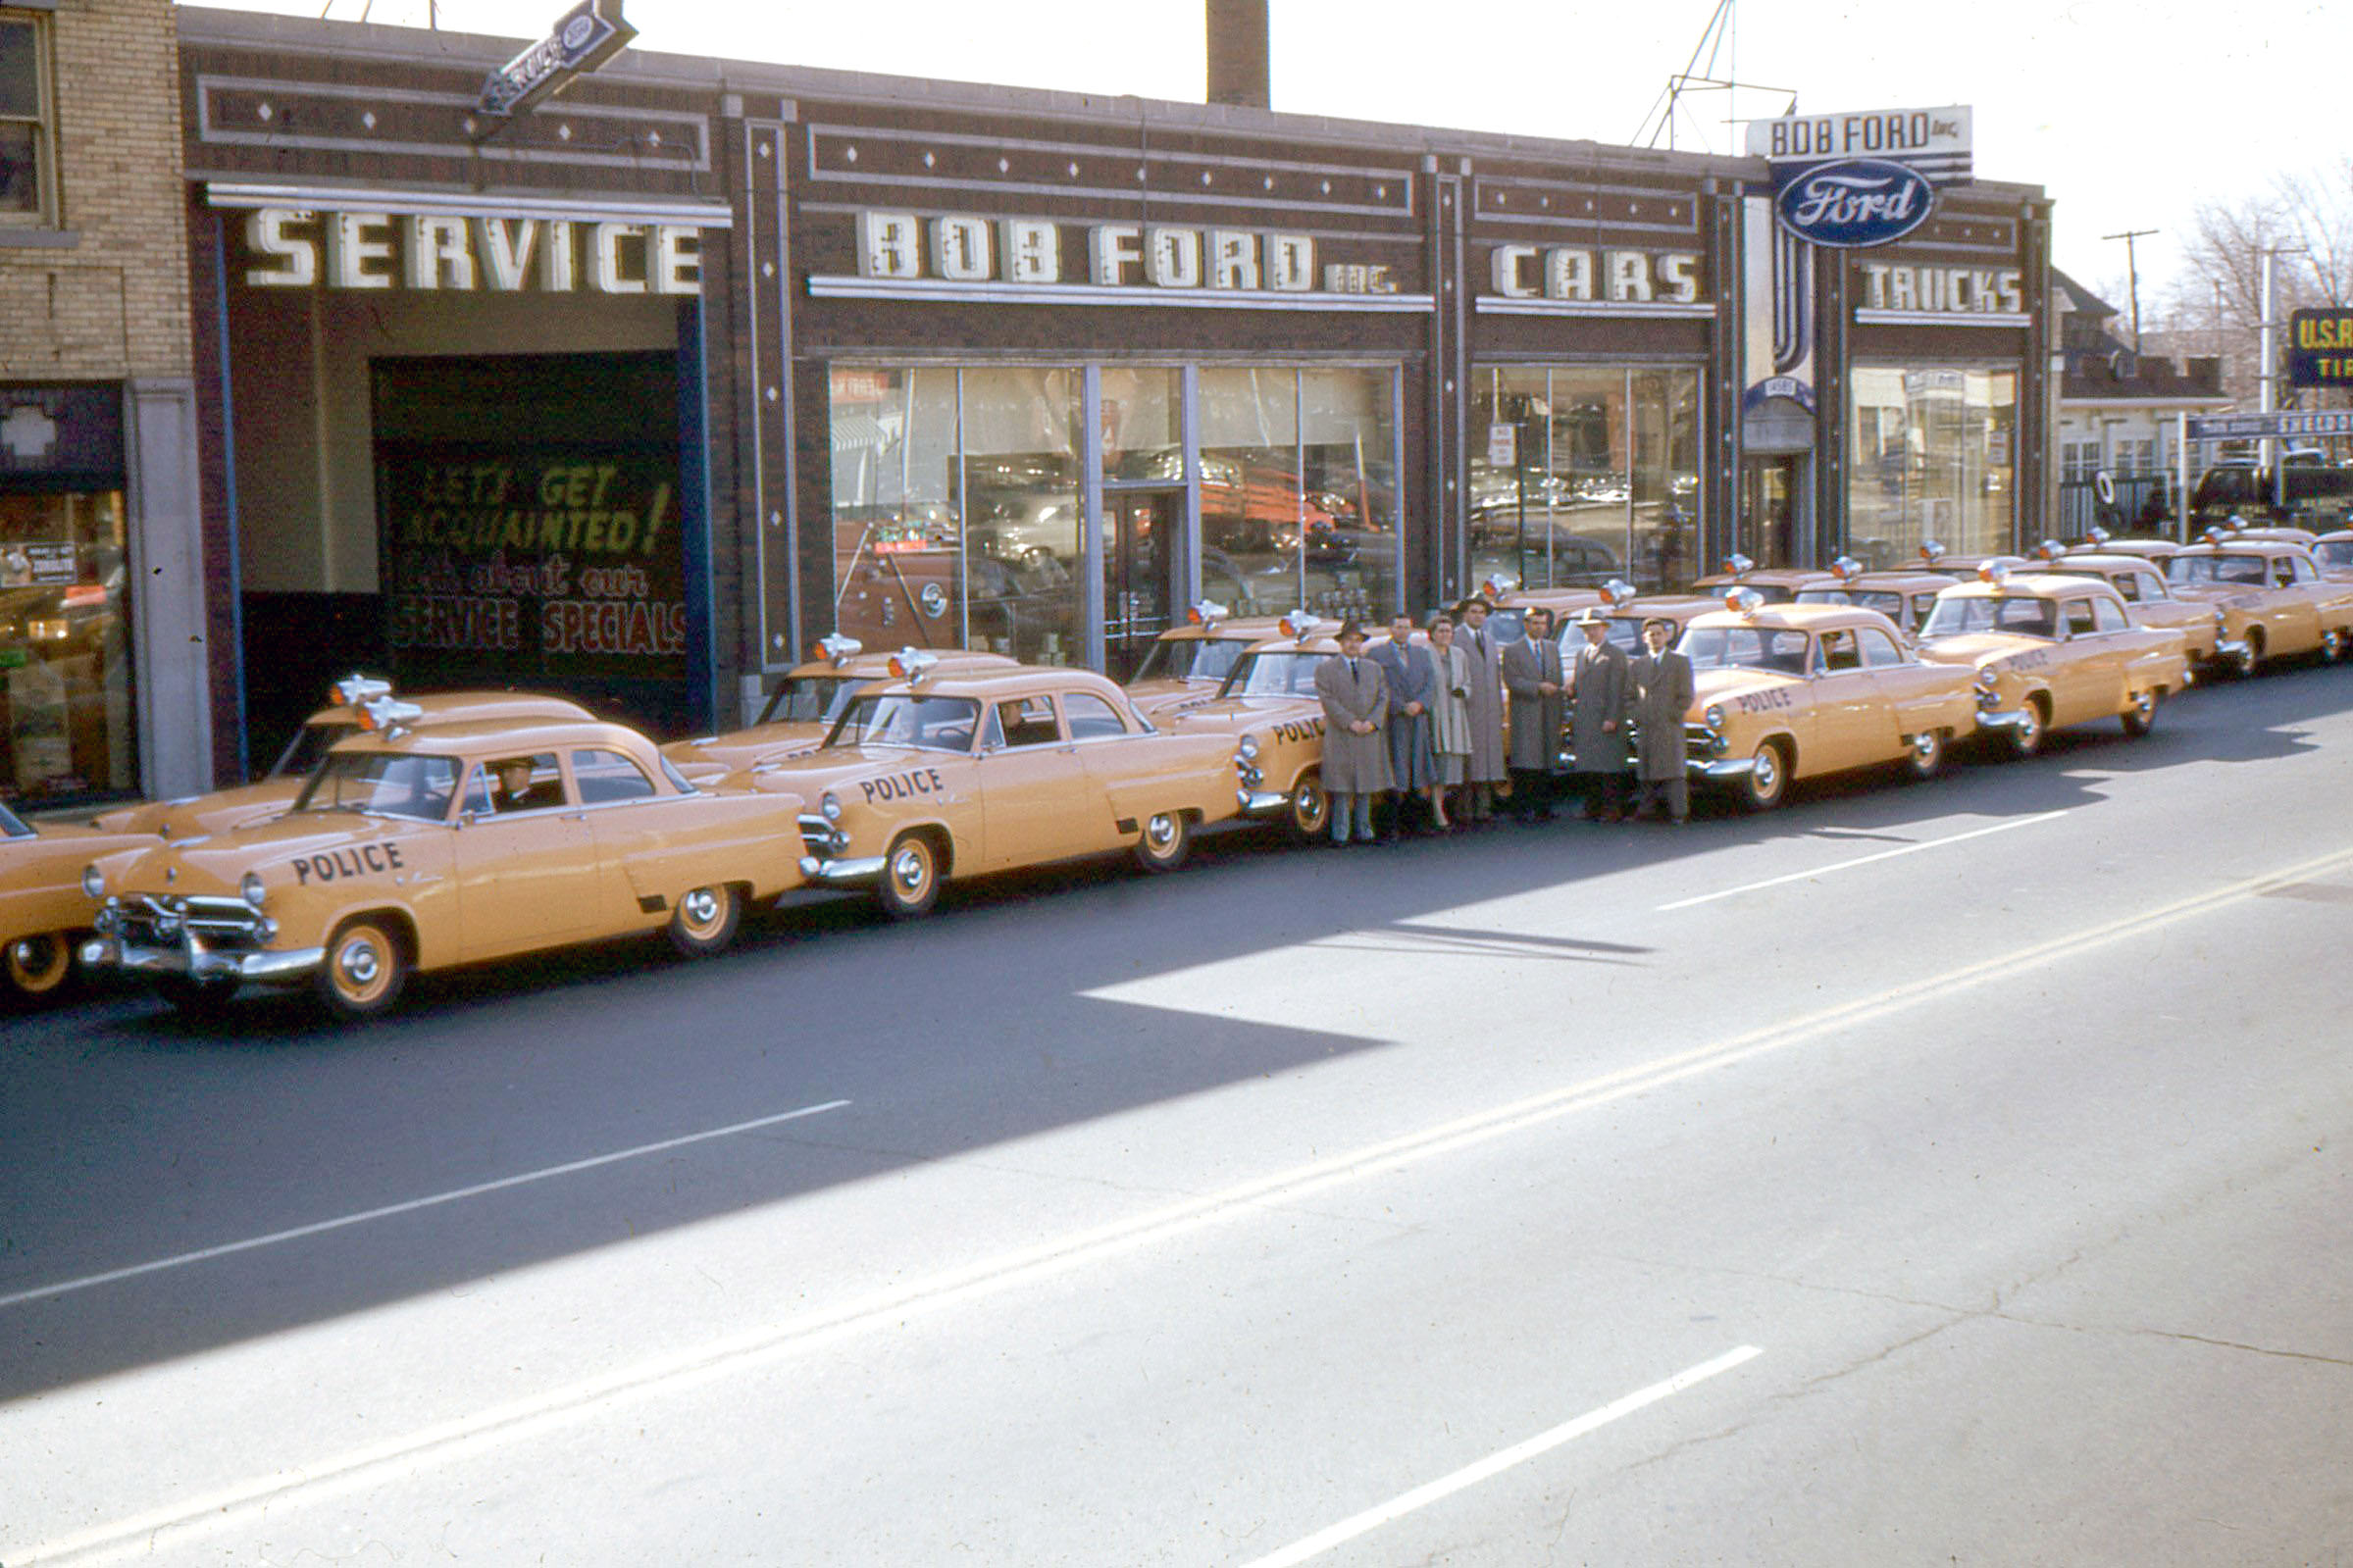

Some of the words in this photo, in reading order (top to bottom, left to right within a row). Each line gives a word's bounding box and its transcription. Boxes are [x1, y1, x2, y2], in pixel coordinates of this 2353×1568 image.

[1771, 120, 1832, 157] BOB
[1843, 113, 1928, 153] FORD
[1794, 176, 1918, 227] Ford
[246, 208, 700, 295] SERVICE
[856, 210, 1062, 284] BOB
[1089, 225, 1317, 292] FORD
[1491, 244, 1707, 303] CARS
[1866, 264, 2023, 314] TRUCKS
[540, 466, 618, 508] GET
[390, 594, 519, 650] SERVICE
[540, 599, 687, 655] SPECIALS
[1735, 687, 1791, 715] POLICE
[858, 769, 944, 805] POLICE
[292, 842, 404, 886] POLICE
